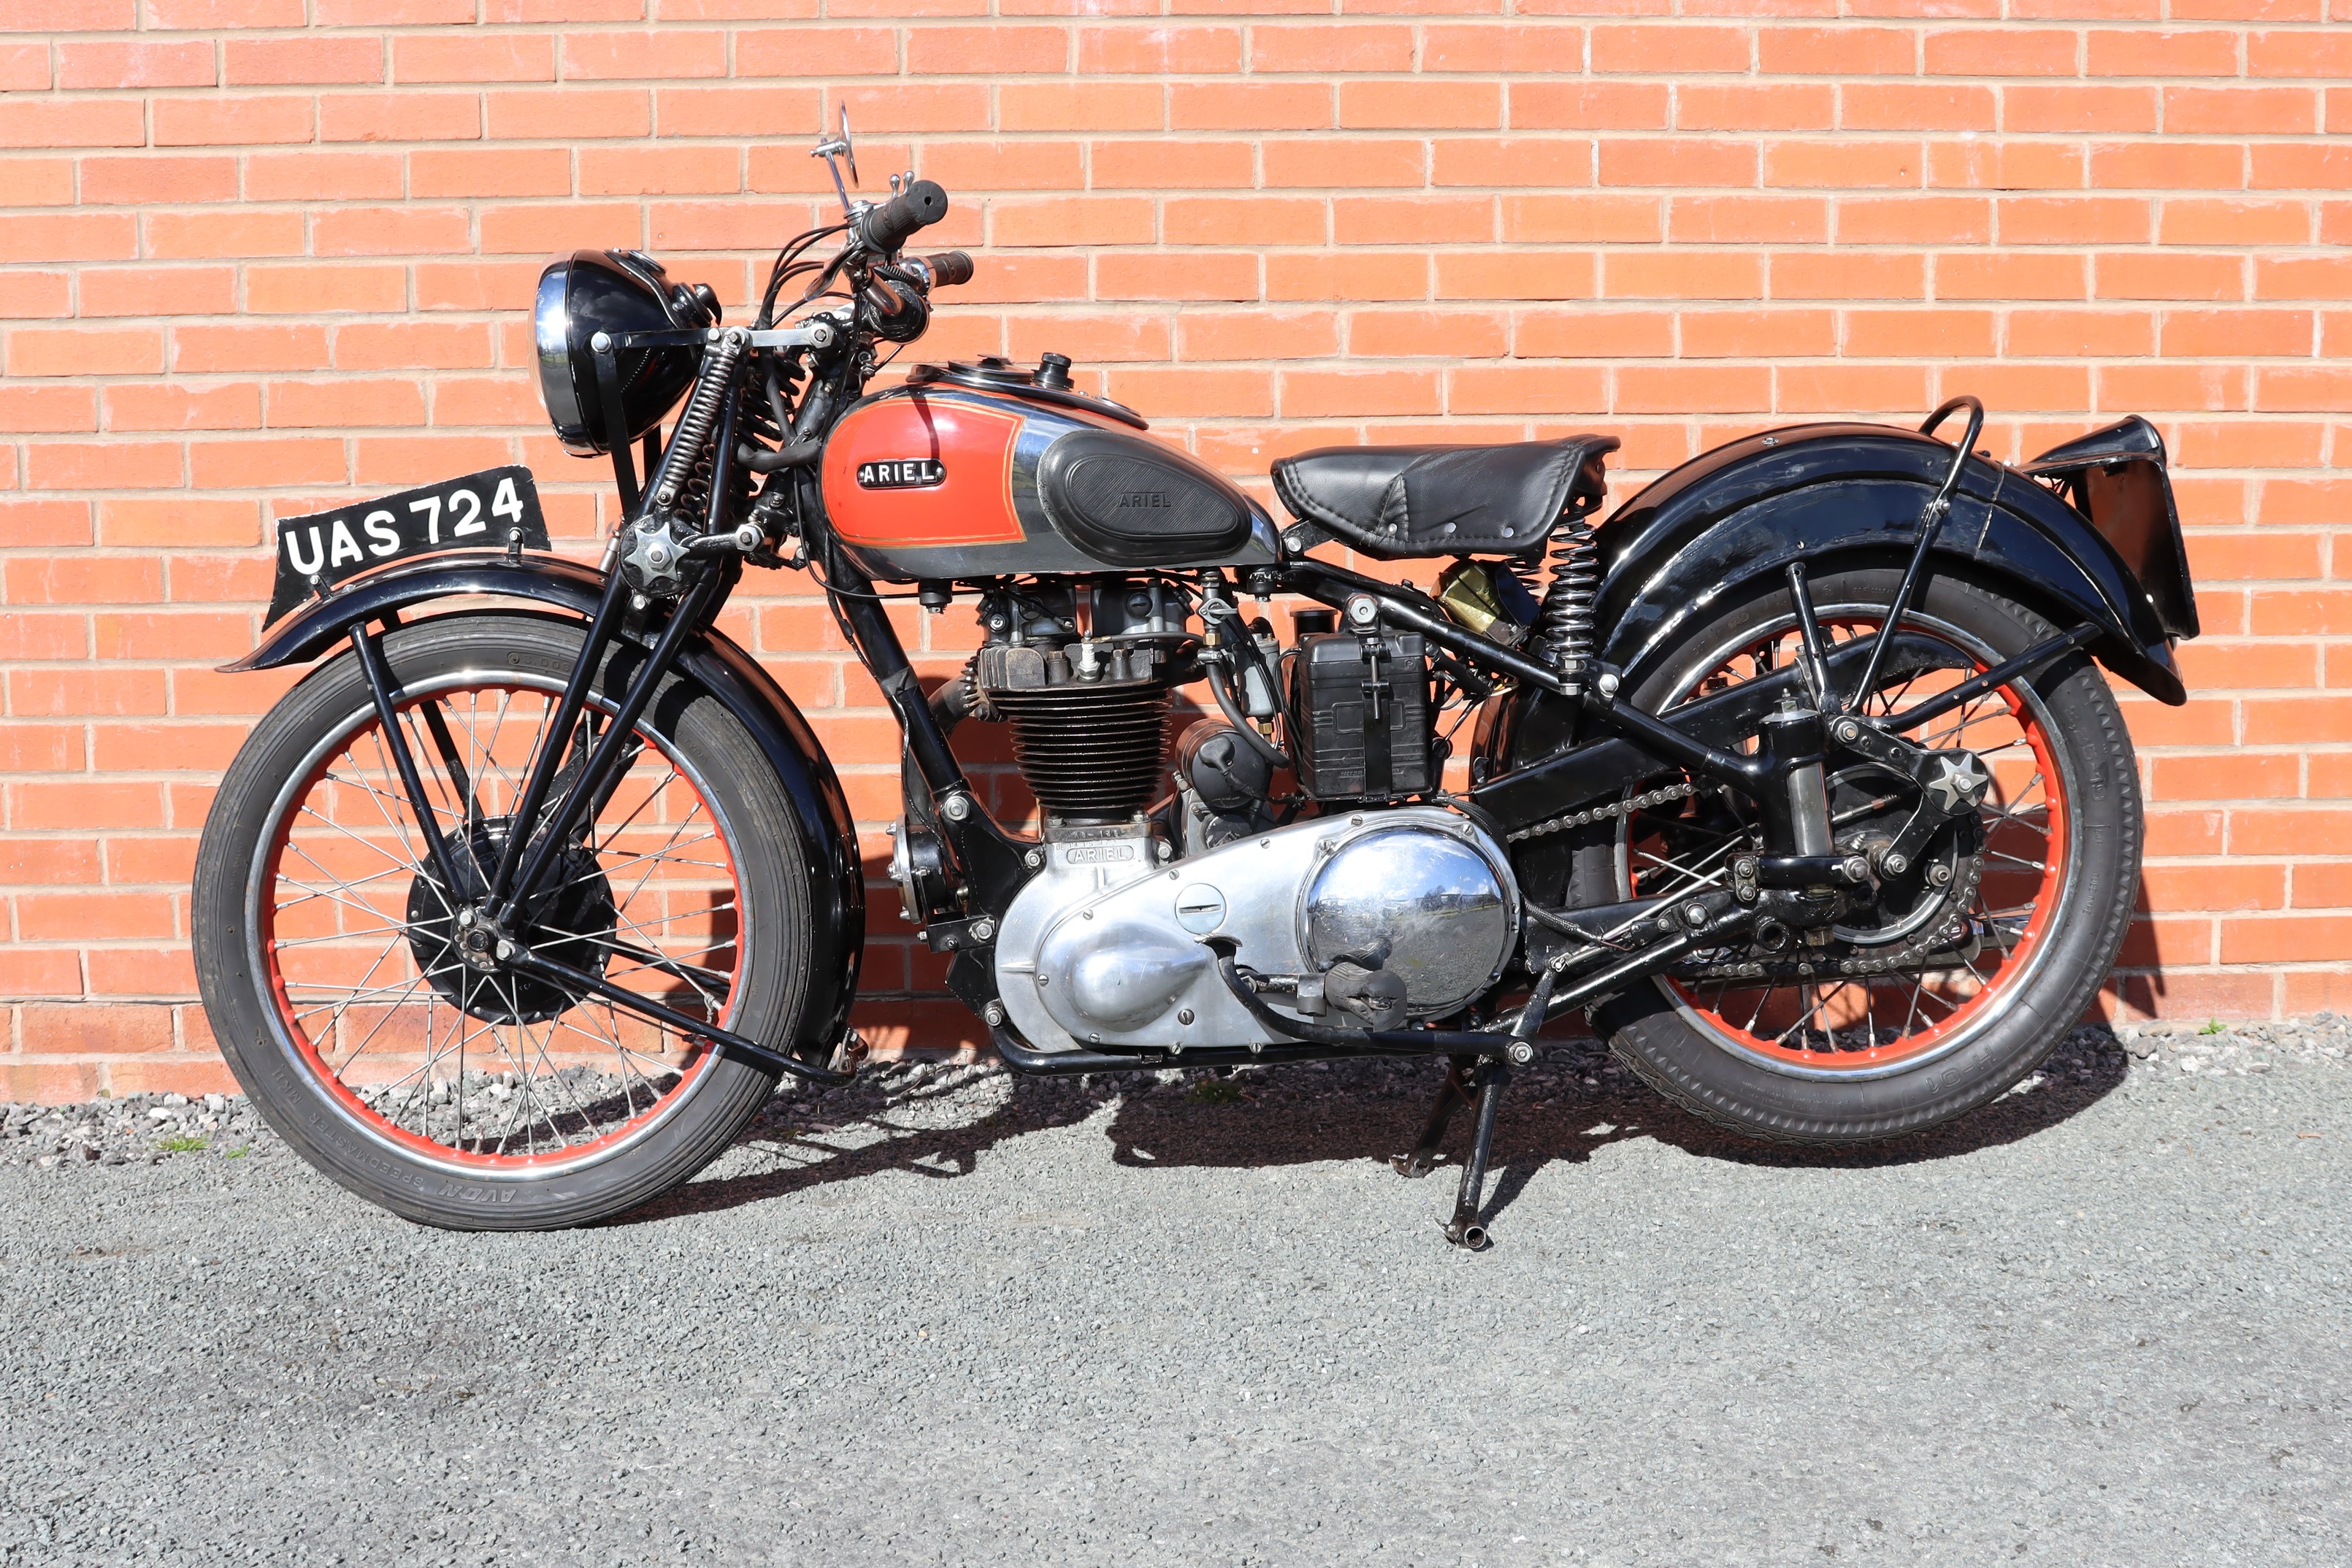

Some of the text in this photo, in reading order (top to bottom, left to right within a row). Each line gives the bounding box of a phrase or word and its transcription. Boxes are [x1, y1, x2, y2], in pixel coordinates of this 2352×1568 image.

[864, 462, 936, 483] ARIEL
[1119, 493, 1171, 507] ARIEL
[285, 477, 524, 575] UAS 724
[1074, 847, 1127, 862] ARIEL
[308, 1112, 424, 1187] SPEEDMASTER
[438, 1183, 518, 1203] AVON
